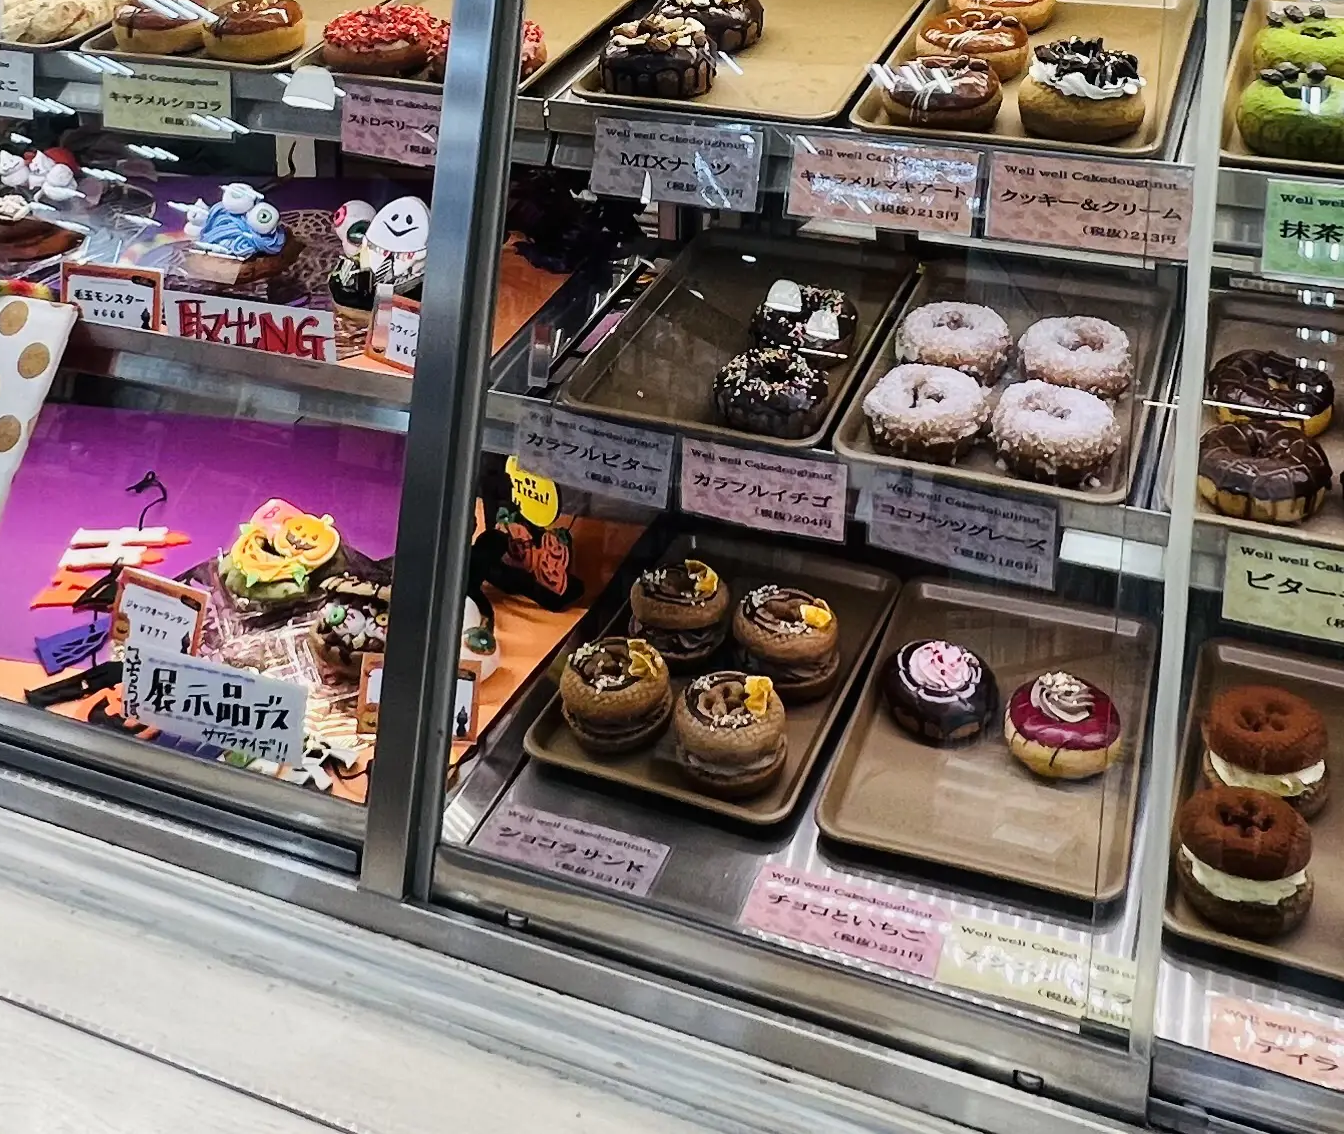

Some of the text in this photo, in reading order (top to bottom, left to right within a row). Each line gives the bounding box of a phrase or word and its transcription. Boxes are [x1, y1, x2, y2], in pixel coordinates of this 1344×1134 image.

[109, 91, 221, 111] キャラメルショコラ
[606, 128, 630, 139] Well
[634, 132, 656, 141] well
[620, 152, 730, 176] MIXナツ
[837, 151, 862, 160] well
[1004, 165, 1178, 191] Well well Cakedoughnut
[1001, 189, 1182, 221] クッキー&クリーム
[1280, 194, 1313, 206] Well
[74, 289, 145, 305] 毛玉モンスター
[526, 432, 662, 472] カラフルビター
[691, 448, 715, 461] Well
[719, 455, 742, 466] well
[693, 472, 832, 508] カラフルイチゴ
[1240, 546, 1273, 560] Well
[1278, 554, 1309, 567] well
[145, 668, 290, 730] 展示品デス
[499, 826, 643, 873] ショコラサンド
[771, 872, 800, 885] Well
[804, 881, 830, 892] well
[768, 894, 926, 942] チョコといちご
[961, 926, 992, 939] Well
[998, 936, 1026, 947] well
